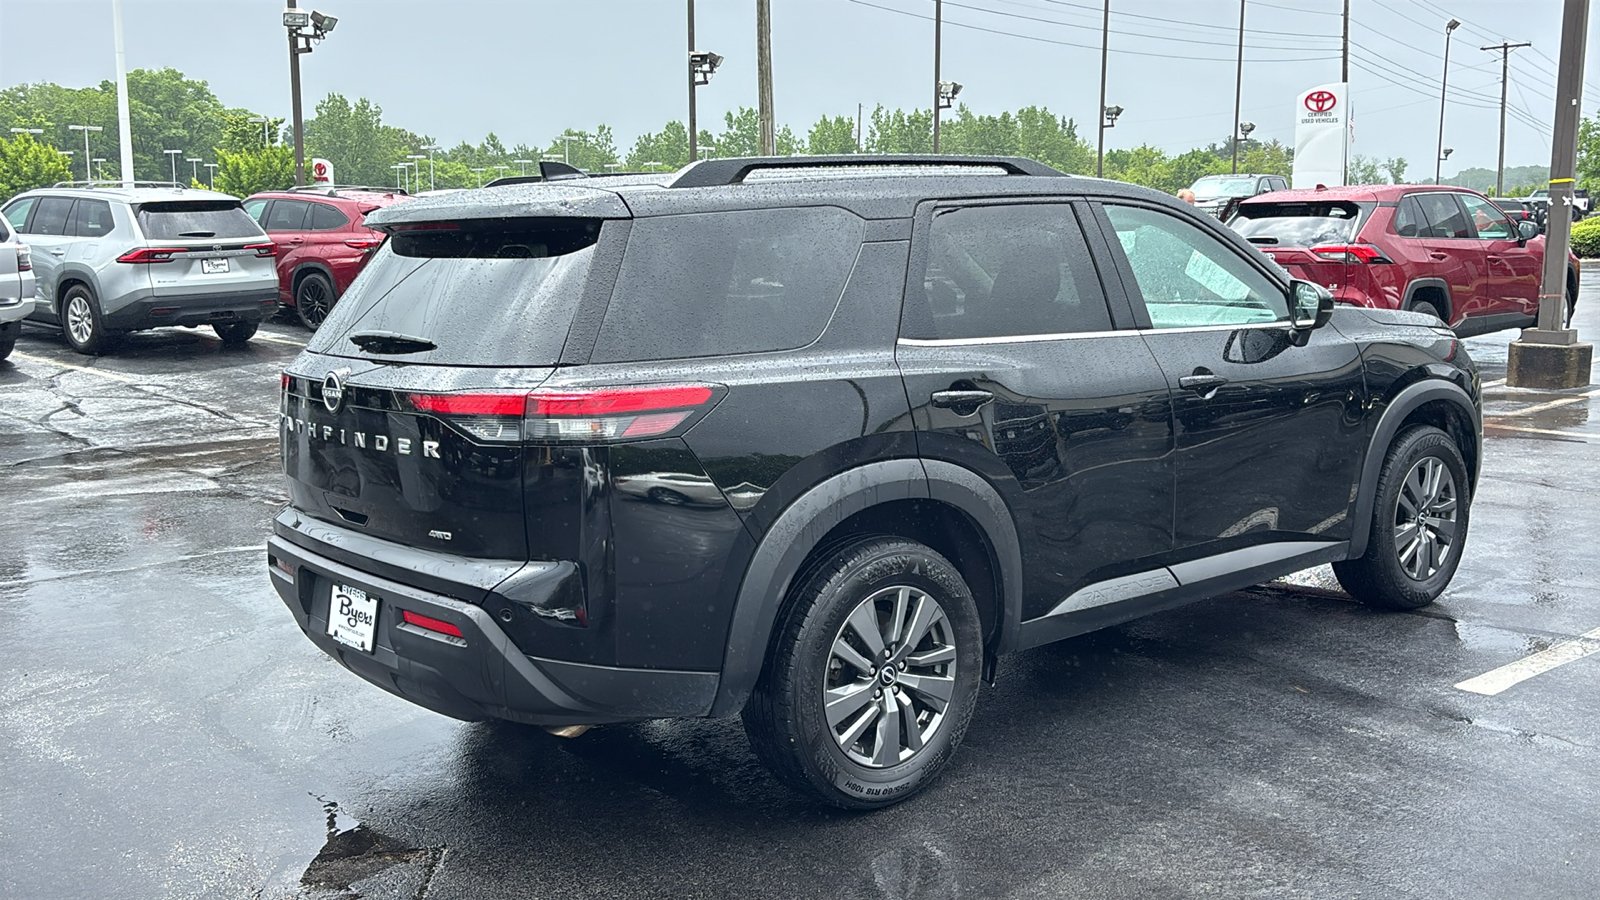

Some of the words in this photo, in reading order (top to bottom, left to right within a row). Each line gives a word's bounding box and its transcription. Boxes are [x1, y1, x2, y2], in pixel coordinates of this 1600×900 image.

[322, 389, 342, 398] ISSAN
[428, 529, 452, 540] 4WD
[342, 584, 367, 600] BYERS
[336, 594, 373, 627] Byers
[844, 780, 865, 793] 108H
[865, 787, 882, 796] R18
[882, 781, 911, 796] 255/60
